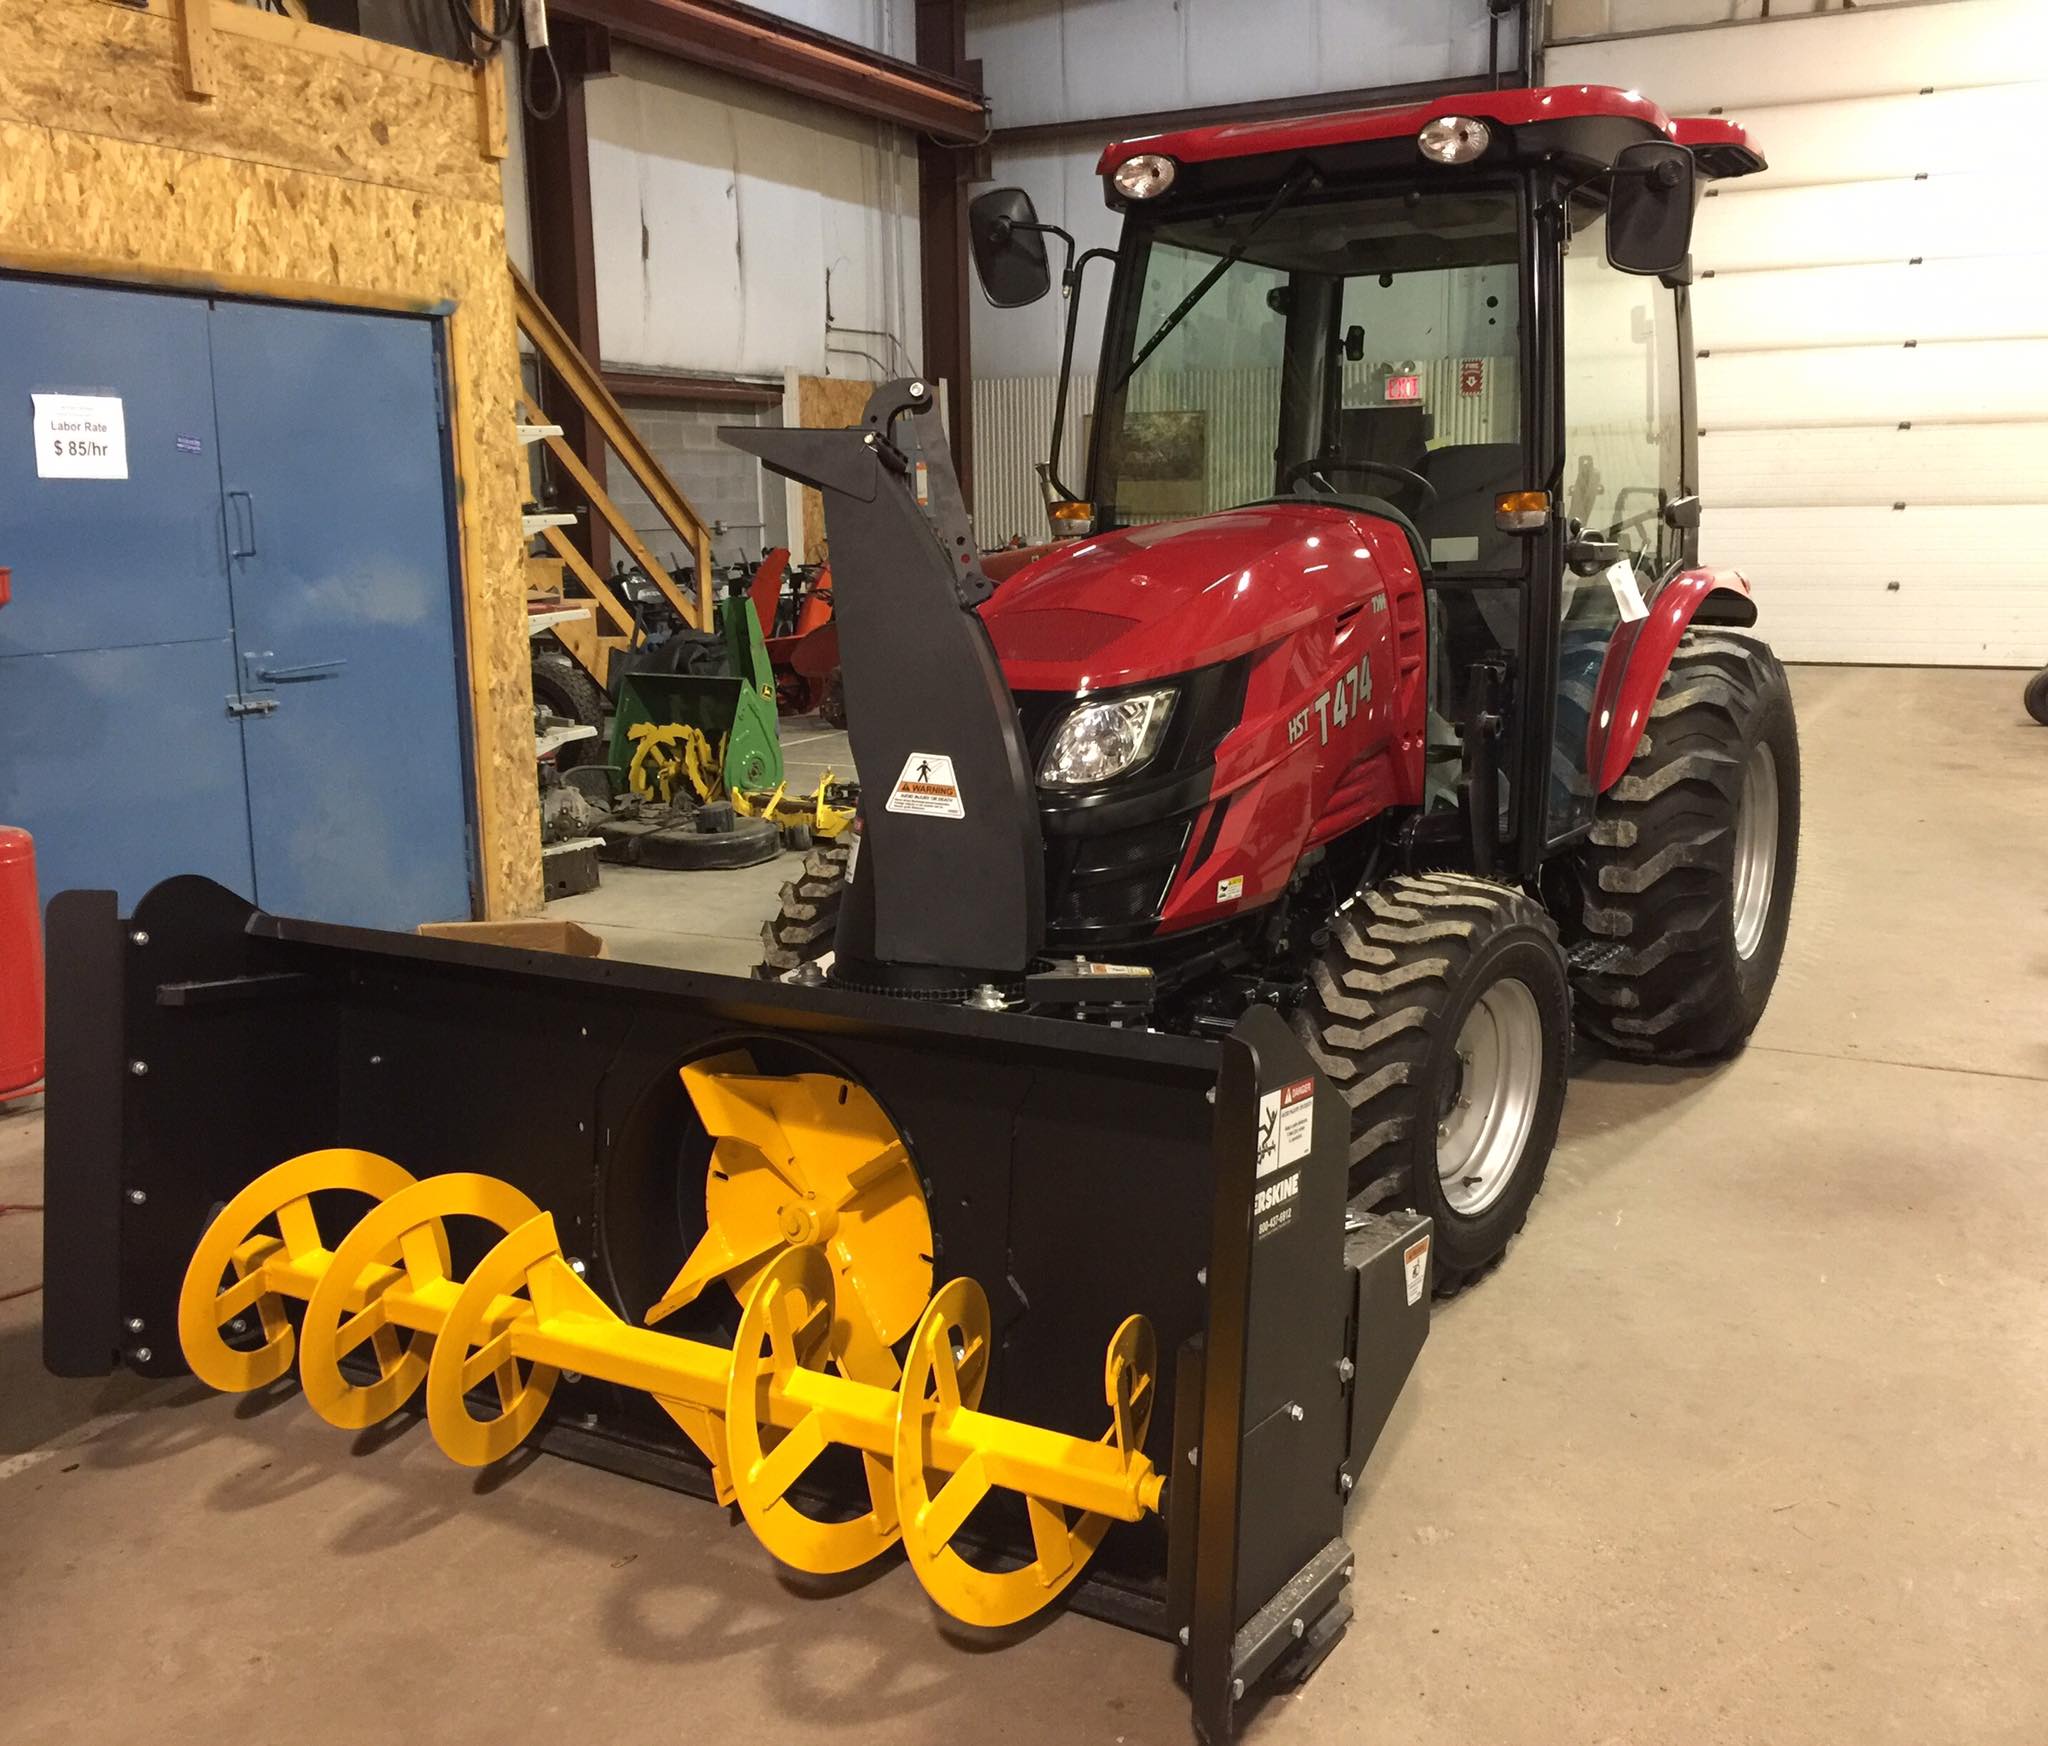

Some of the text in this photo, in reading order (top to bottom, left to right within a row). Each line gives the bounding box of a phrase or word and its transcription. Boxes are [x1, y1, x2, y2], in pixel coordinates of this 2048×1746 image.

[1389, 377, 1418, 398] EXIT
[51, 420, 108, 433] Labor Rate
[54, 440, 108, 457] $ 85/hr
[1288, 655, 1373, 746] HST T474
[912, 784, 954, 795] WARNING
[1292, 1082, 1312, 1098] DANGER
